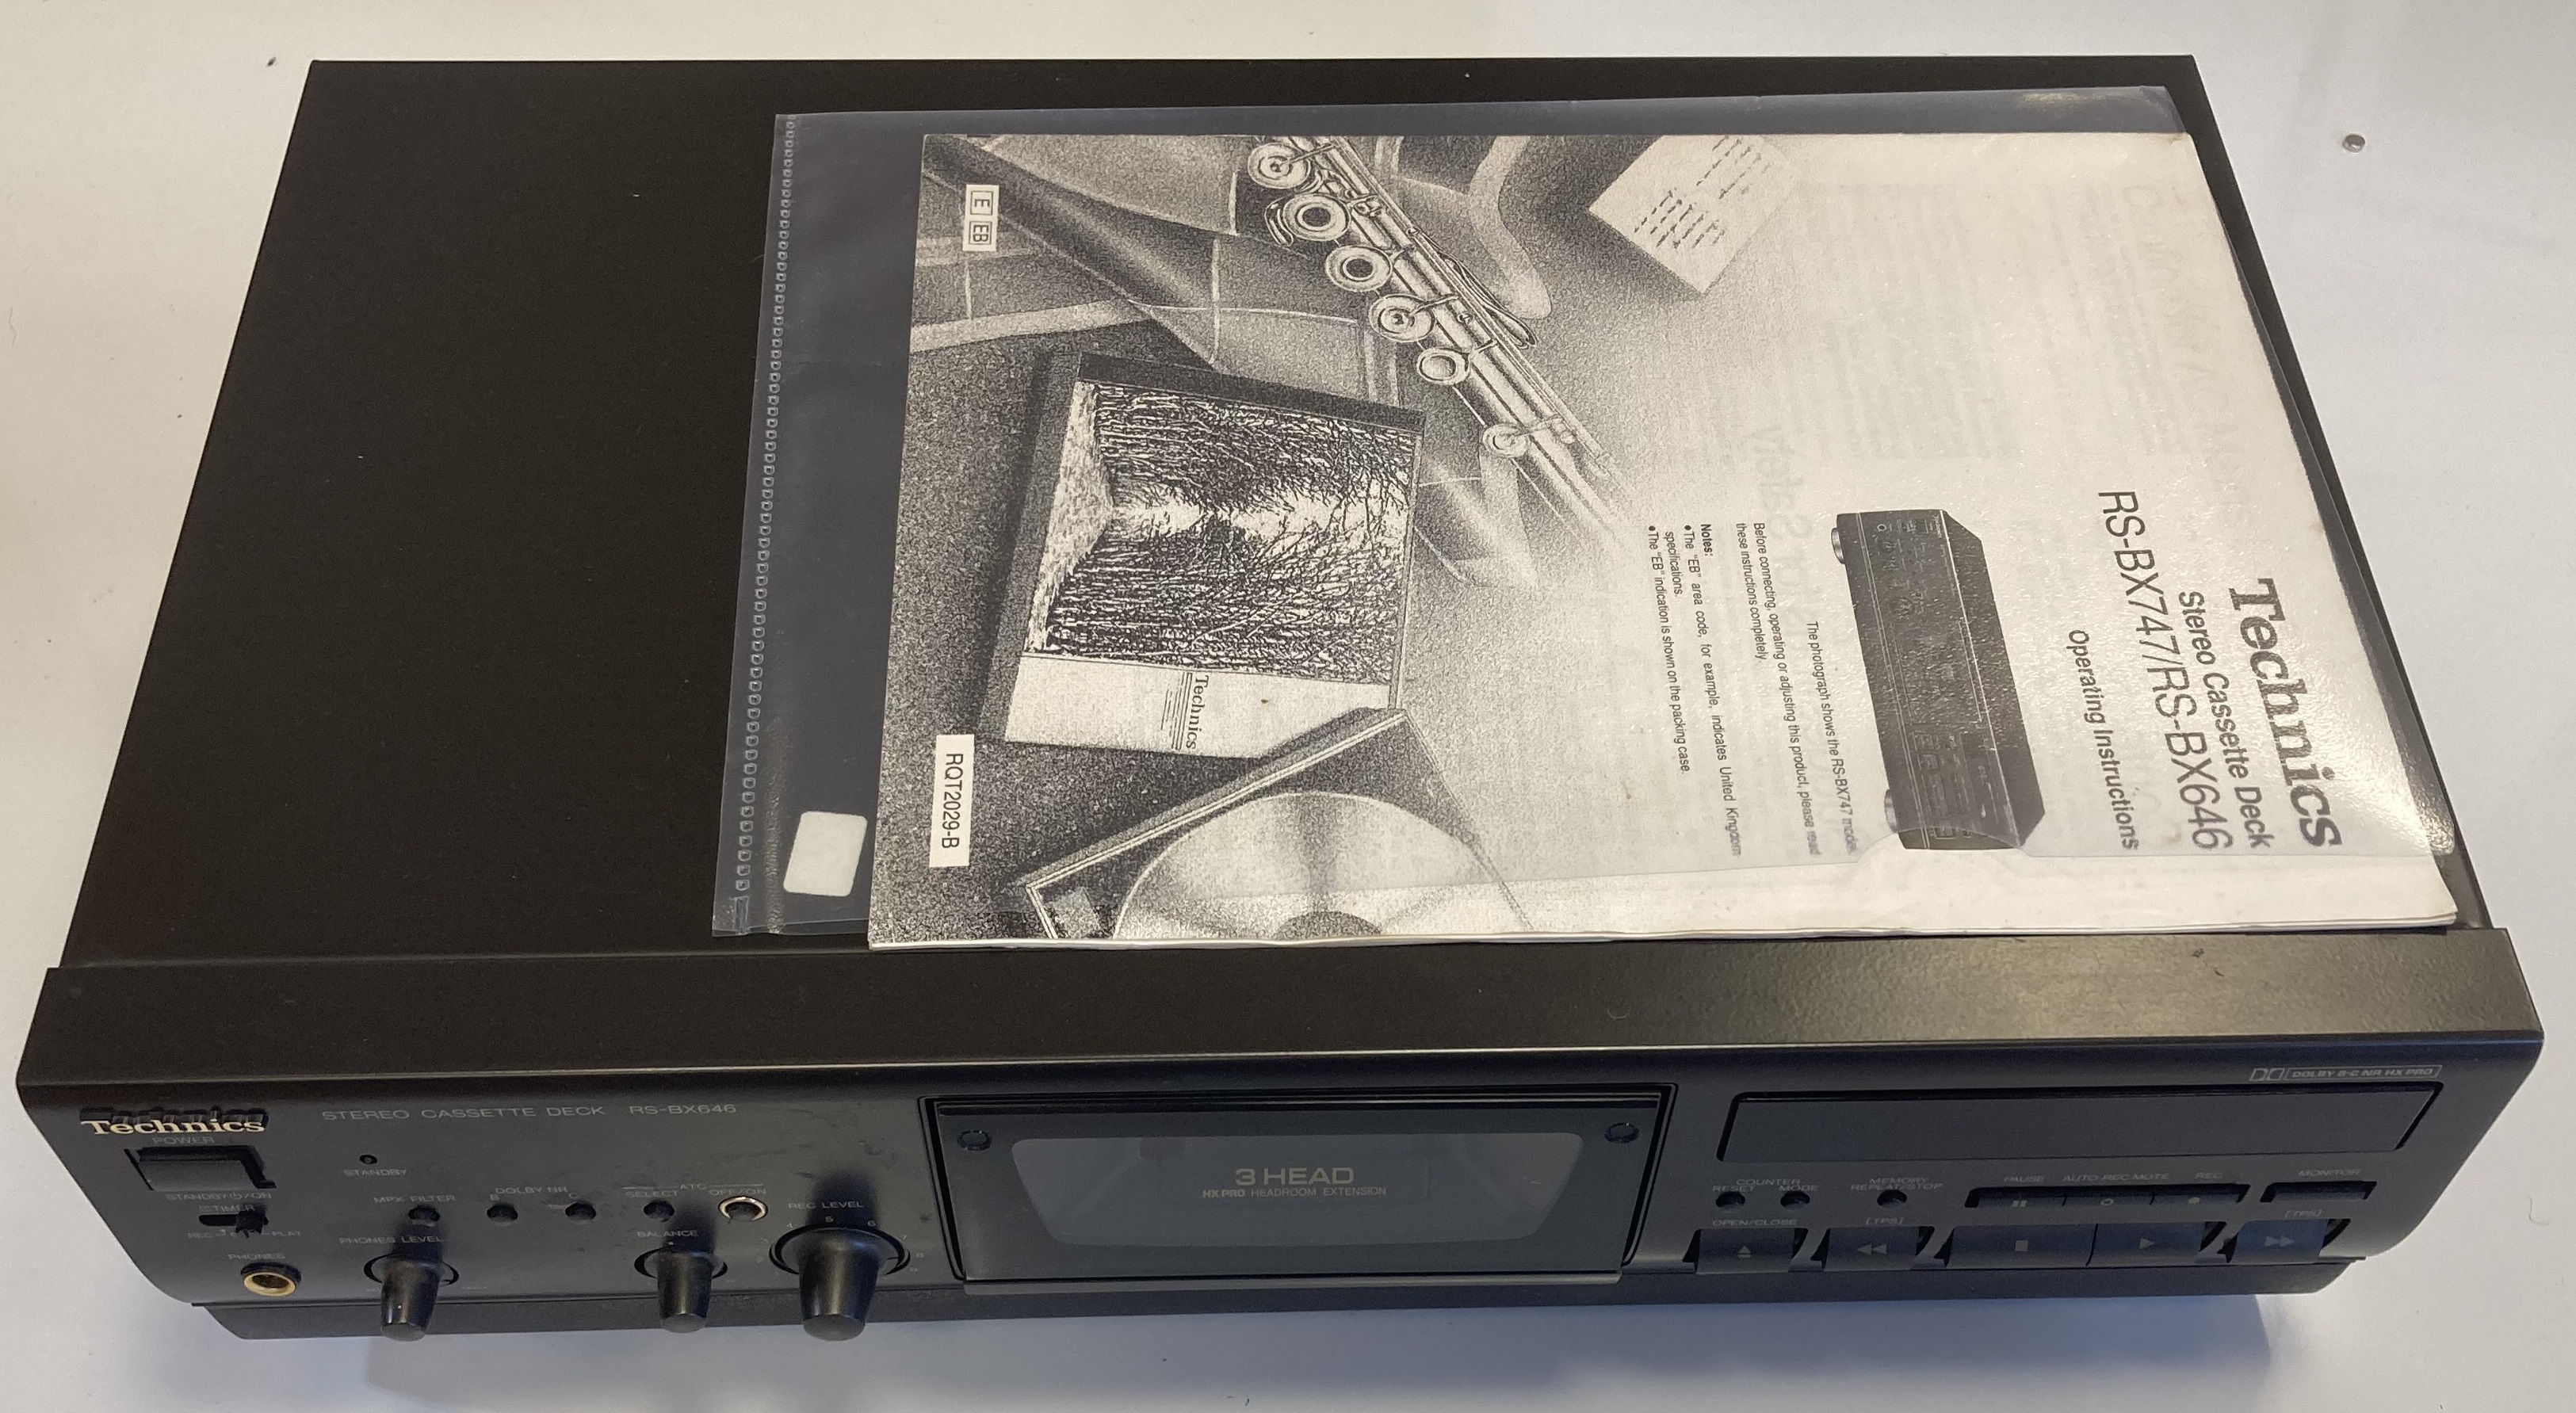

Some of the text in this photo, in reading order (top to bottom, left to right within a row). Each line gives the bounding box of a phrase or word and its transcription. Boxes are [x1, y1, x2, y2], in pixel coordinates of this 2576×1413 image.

[974, 198, 991, 208] E
[973, 224, 989, 243] EB
[1699, 523, 1714, 556] Notes:
[1735, 522, 1749, 549] these
[1752, 522, 1768, 554] Before
[1663, 531, 1682, 598] specifications.
[1740, 551, 1758, 605] instructions
[1691, 582, 1704, 605] area
[1759, 556, 1778, 611] connecting,
[1653, 577, 1670, 624] indication
[1660, 625, 1673, 634] is
[1695, 610, 1710, 638] code,
[1767, 613, 1787, 660] operating
[1806, 621, 1820, 641] The
[1661, 635, 1676, 669] shown
[1700, 643, 1713, 659] for
[1667, 670, 1678, 683] on
[1777, 662, 1788, 674] or
[1806, 642, 1832, 701] photograph
[2098, 491, 2234, 850] RS-BX747/RS-BX646
[1668, 685, 1682, 702] the
[1703, 663, 1721, 709] example,
[1778, 675, 1797, 722] adjusting
[1185, 674, 1210, 750] Technics
[1668, 704, 1687, 744] packing
[1821, 702, 1836, 737] shows
[2178, 591, 2275, 849] Stereo Cassette Deck
[2228, 577, 2344, 848] Technics
[1710, 714, 1728, 761] indicates
[1787, 724, 1802, 743] this
[2066, 629, 2140, 850] Operating Instructions
[1677, 746, 1691, 775] case.
[1827, 739, 1840, 756] the
[1787, 746, 1810, 789] product,
[1719, 766, 1737, 802] United
[1830, 758, 1854, 815] RS-BX747
[941, 753, 965, 849] RQT2029-B
[1796, 791, 1815, 828] please
[2291, 1069, 2337, 1079] DOLBY
[2361, 1068, 2383, 1077] NR
[2405, 1067, 2434, 1076] PRO
[322, 1103, 737, 1121] STEREO CASSETTE DECK RS-BX646
[80, 1118, 266, 1135] Technics
[152, 1136, 215, 1144] POWER
[342, 1168, 407, 1177] STANDBY
[1234, 1166, 1355, 1186] 3 HEAD
[1736, 1178, 1801, 1186] COUNTER
[495, 1186, 543, 1195] DOLBY
[709, 1187, 767, 1197] OFF/ON
[1202, 1186, 1387, 1199] HX PRO HEADROOM EXTENSION
[788, 1200, 865, 1210] REC LEVEL
[636, 1229, 699, 1238] BALANCE
[1712, 1218, 1798, 1227] OPEN/CLOSE
[401, 1235, 445, 1244] LEVEL
[226, 1252, 286, 1261] PHONES
